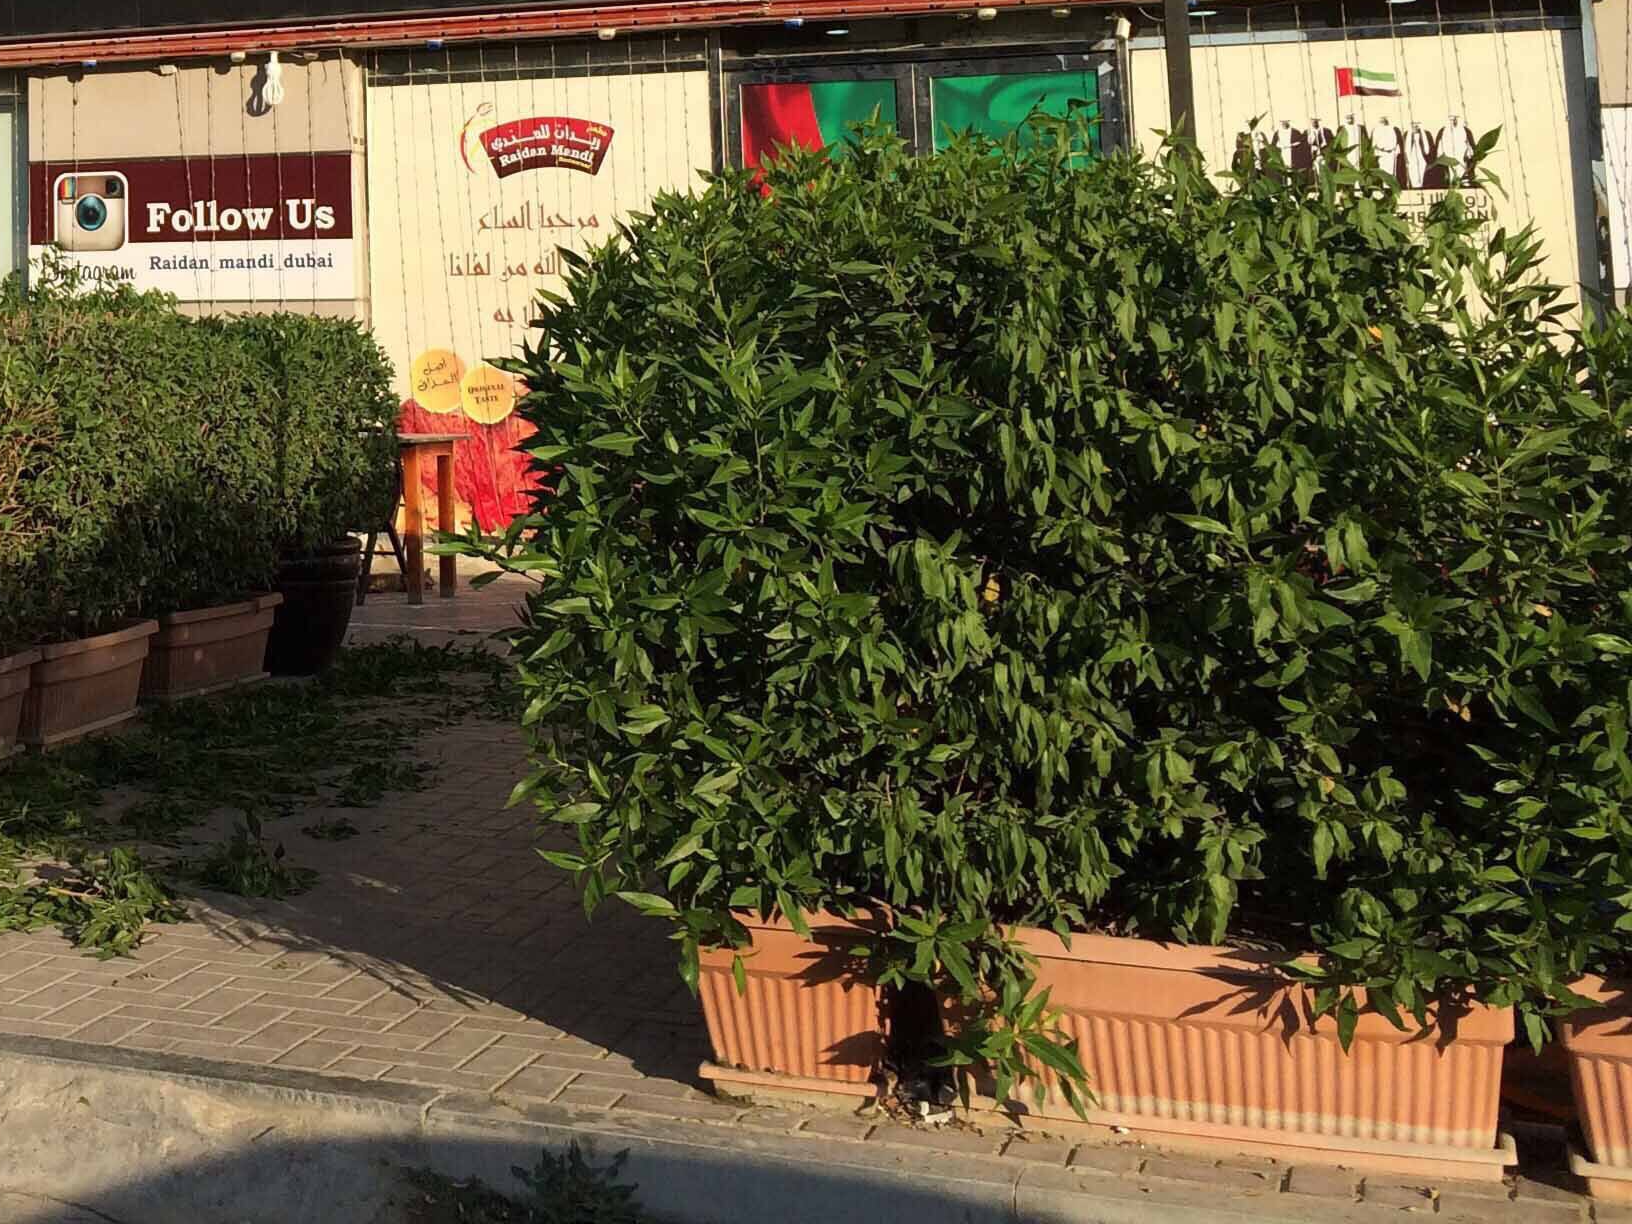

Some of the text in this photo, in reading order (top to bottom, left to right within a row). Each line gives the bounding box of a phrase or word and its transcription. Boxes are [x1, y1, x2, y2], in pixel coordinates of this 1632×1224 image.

[499, 145, 547, 167] Raidan
[550, 144, 595, 163] Mandi
[146, 198, 336, 233] Follow Us
[44, 256, 136, 291] Intagram
